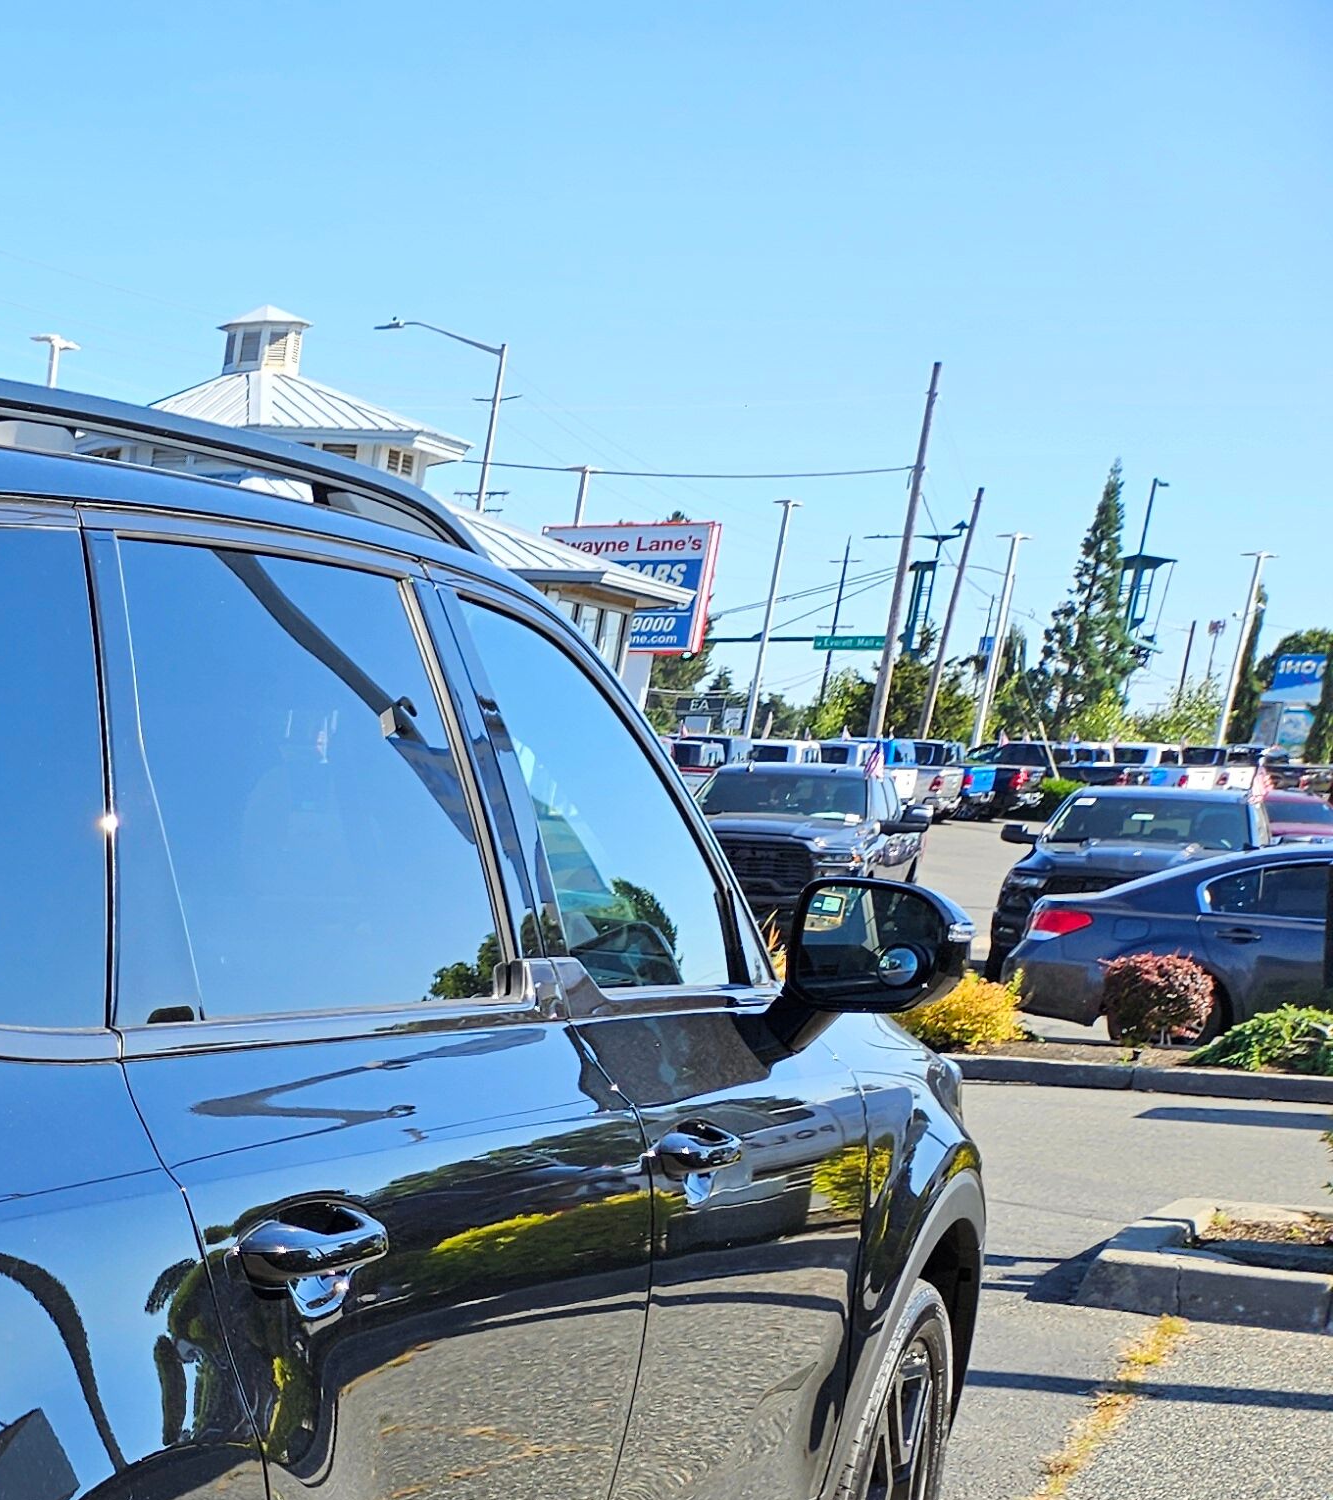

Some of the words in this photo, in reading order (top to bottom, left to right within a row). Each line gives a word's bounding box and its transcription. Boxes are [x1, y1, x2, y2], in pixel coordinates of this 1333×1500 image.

[554, 538, 629, 556] wayne
[636, 535, 702, 552] Lane's
[630, 634, 677, 644] ne.com
